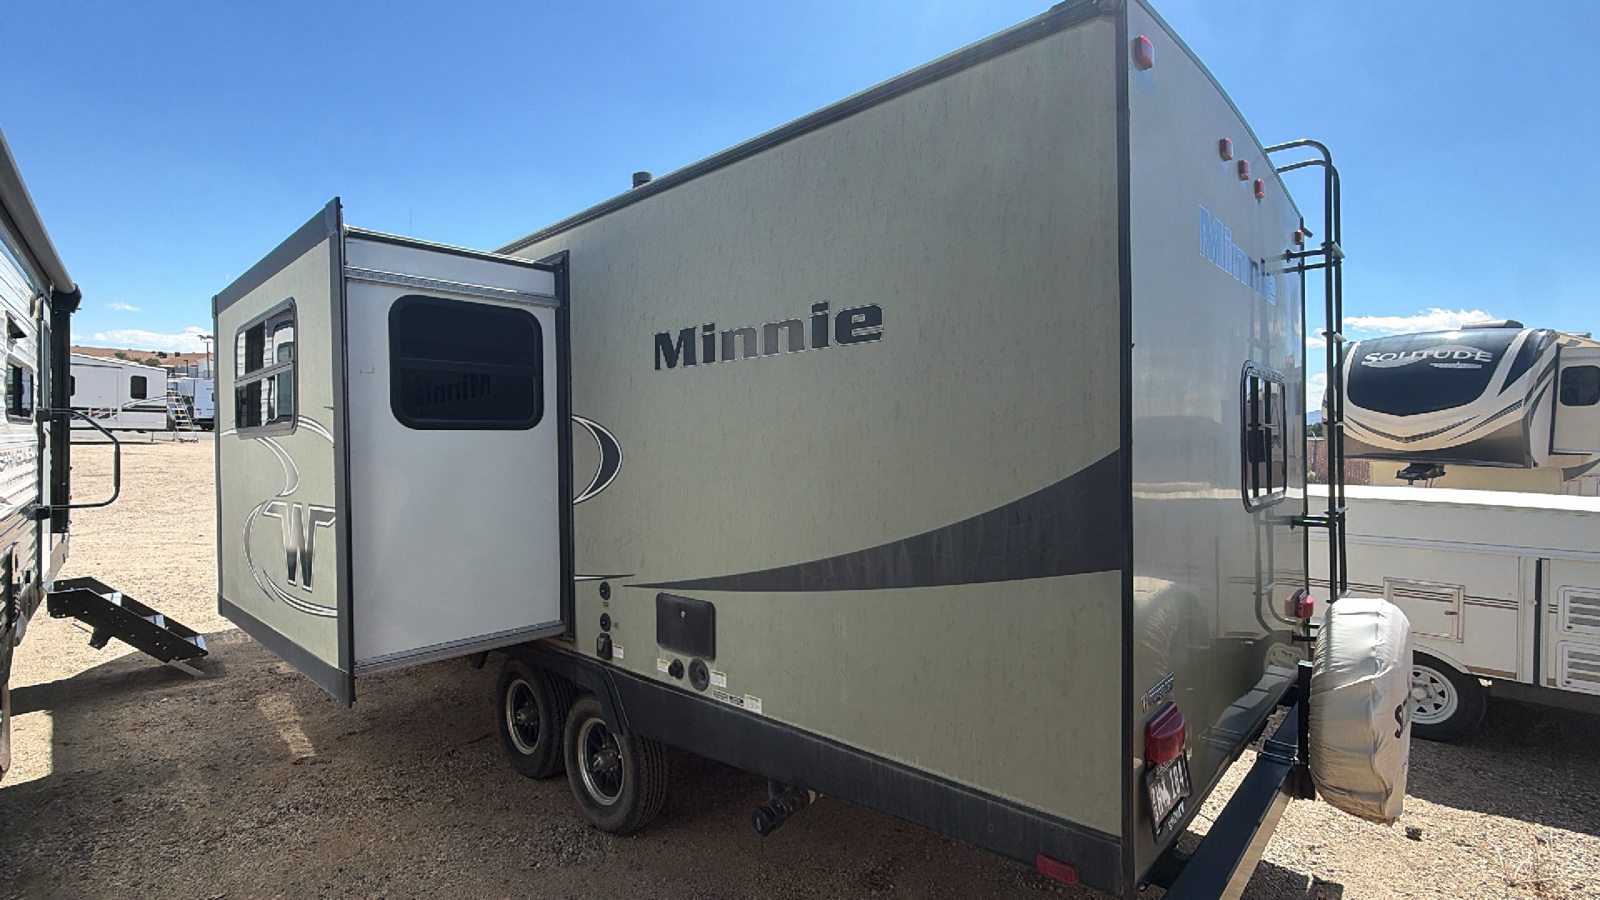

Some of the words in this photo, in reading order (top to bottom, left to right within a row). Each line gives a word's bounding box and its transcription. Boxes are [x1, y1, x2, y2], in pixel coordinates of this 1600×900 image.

[1199, 204, 1276, 306] Minnie
[653, 300, 884, 371] Minnie
[1364, 349, 1493, 363] SOLITUDE
